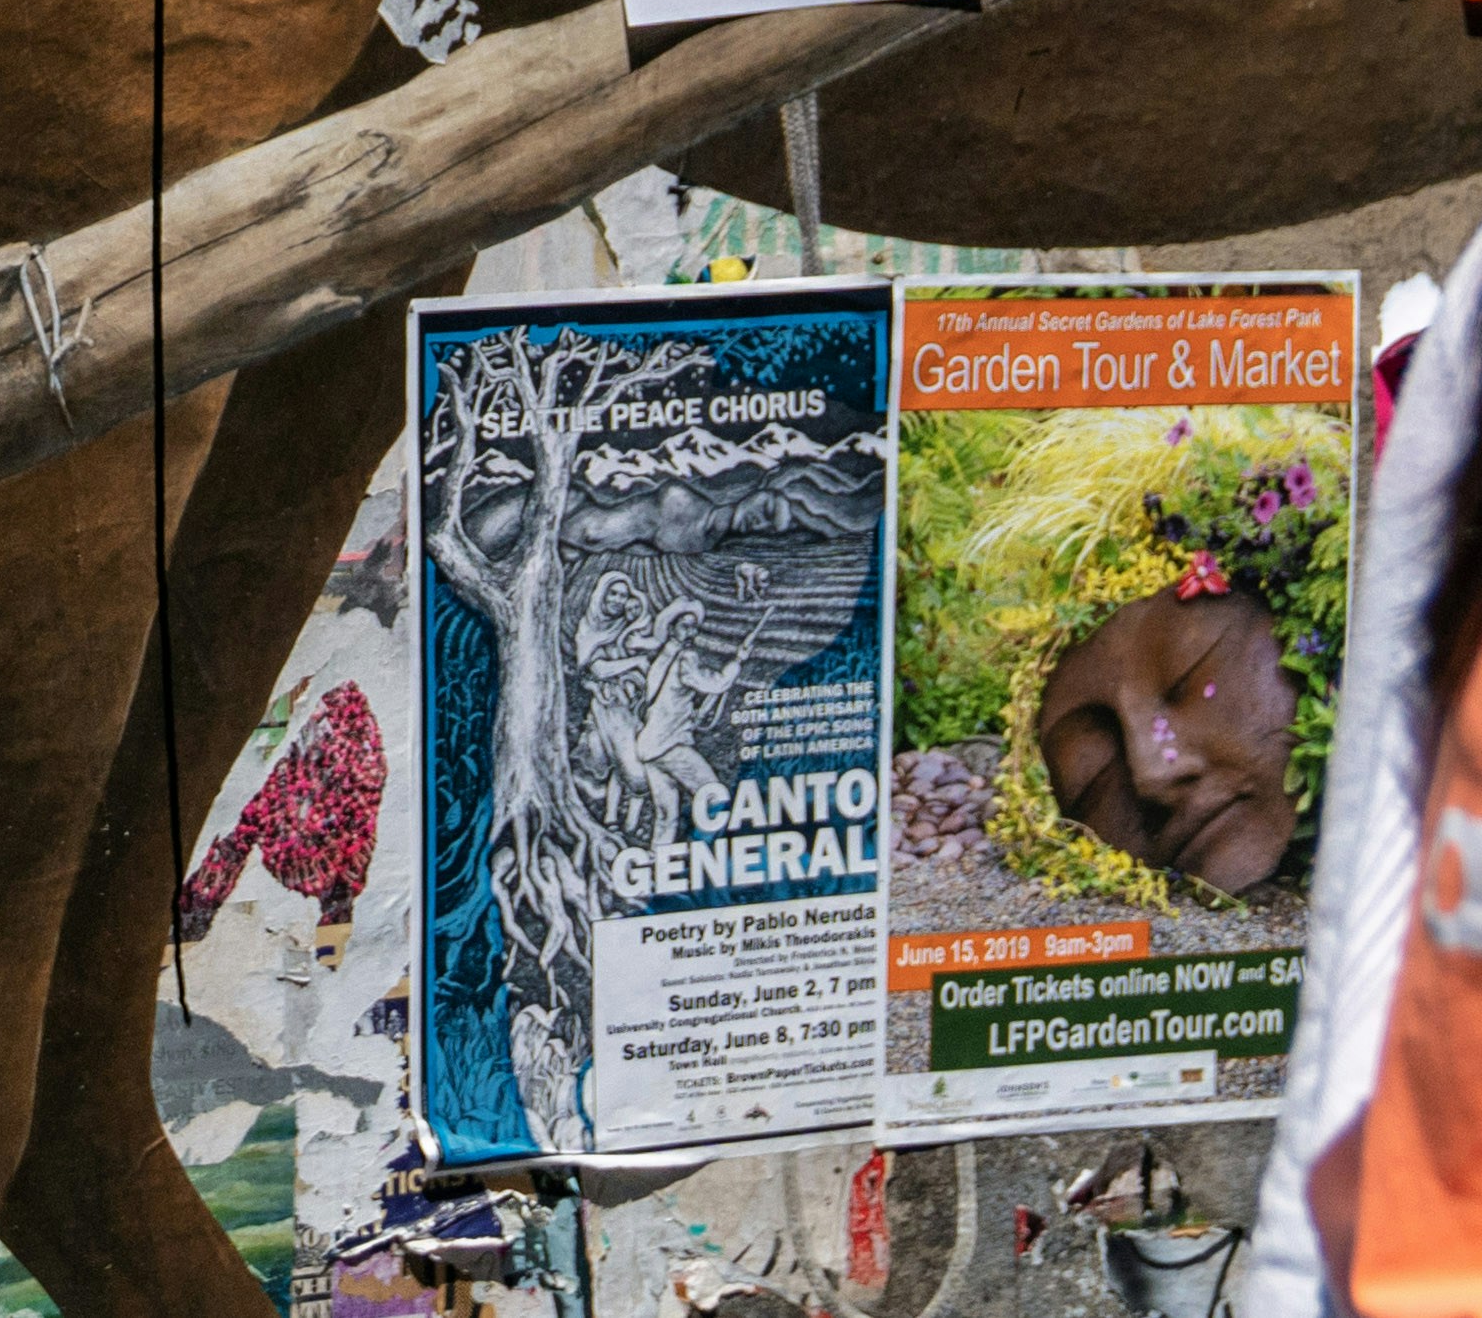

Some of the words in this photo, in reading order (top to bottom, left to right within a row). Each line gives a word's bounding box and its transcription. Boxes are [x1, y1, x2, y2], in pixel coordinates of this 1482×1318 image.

[912, 344, 1061, 398] Garden
[1071, 341, 1161, 393] Tour
[1169, 341, 1197, 390] &
[1210, 337, 1343, 389] Market
[610, 396, 703, 432] PEACE
[709, 387, 826, 424] CHORUS
[691, 767, 877, 833] CANTO
[610, 824, 877, 898] GENERAL
[641, 923, 706, 944] Poetry
[713, 918, 736, 937] by
[742, 912, 798, 933] Pablo
[804, 904, 876, 926] Neruda
[896, 940, 945, 966] June
[949, 939, 979, 966] 15,
[984, 935, 1031, 962] 2019
[1045, 930, 1134, 959] 9am-3pm
[940, 979, 1006, 1010] Order
[1011, 971, 1095, 1005] Tickets
[1099, 966, 1170, 998] online
[1174, 961, 1234, 992] NOW
[1237, 964, 1266, 983] and
[988, 1007, 1284, 1056] LFPGardenTour.com
